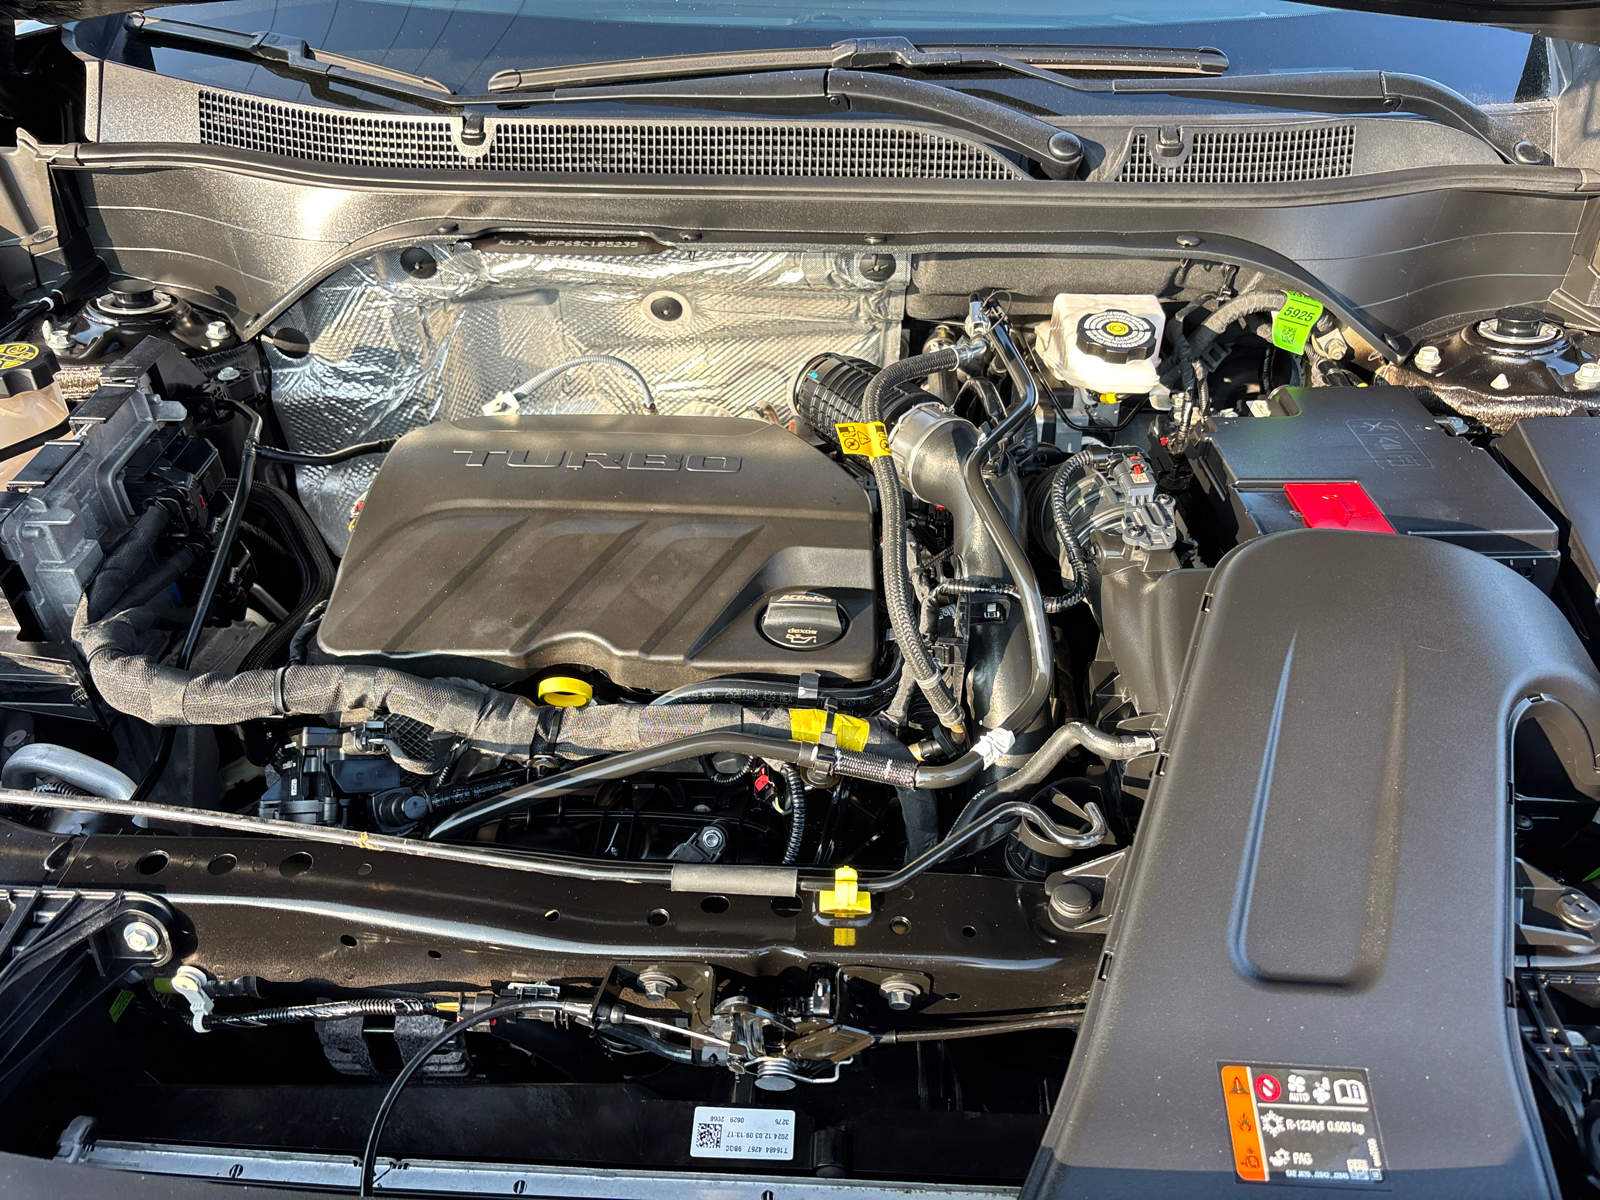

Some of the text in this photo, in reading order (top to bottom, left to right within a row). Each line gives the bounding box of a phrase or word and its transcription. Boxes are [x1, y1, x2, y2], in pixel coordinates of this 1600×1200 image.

[1283, 306, 1316, 322] 5925
[453, 449, 743, 473] TURBO
[776, 594, 832, 603] ACDelco
[787, 627, 819, 635] dexos
[1288, 1092, 1310, 1103] AUTO
[729, 1116, 745, 1124] 0629
[774, 1118, 790, 1126] 3275
[1285, 1118, 1366, 1136] R-1234yf 0.600 kg
[726, 1131, 789, 1140] 2024.12.03 09:13:17
[747, 1145, 762, 1153] 4267
[765, 1146, 788, 1154] T16484
[1292, 1152, 1314, 1166] PAG
